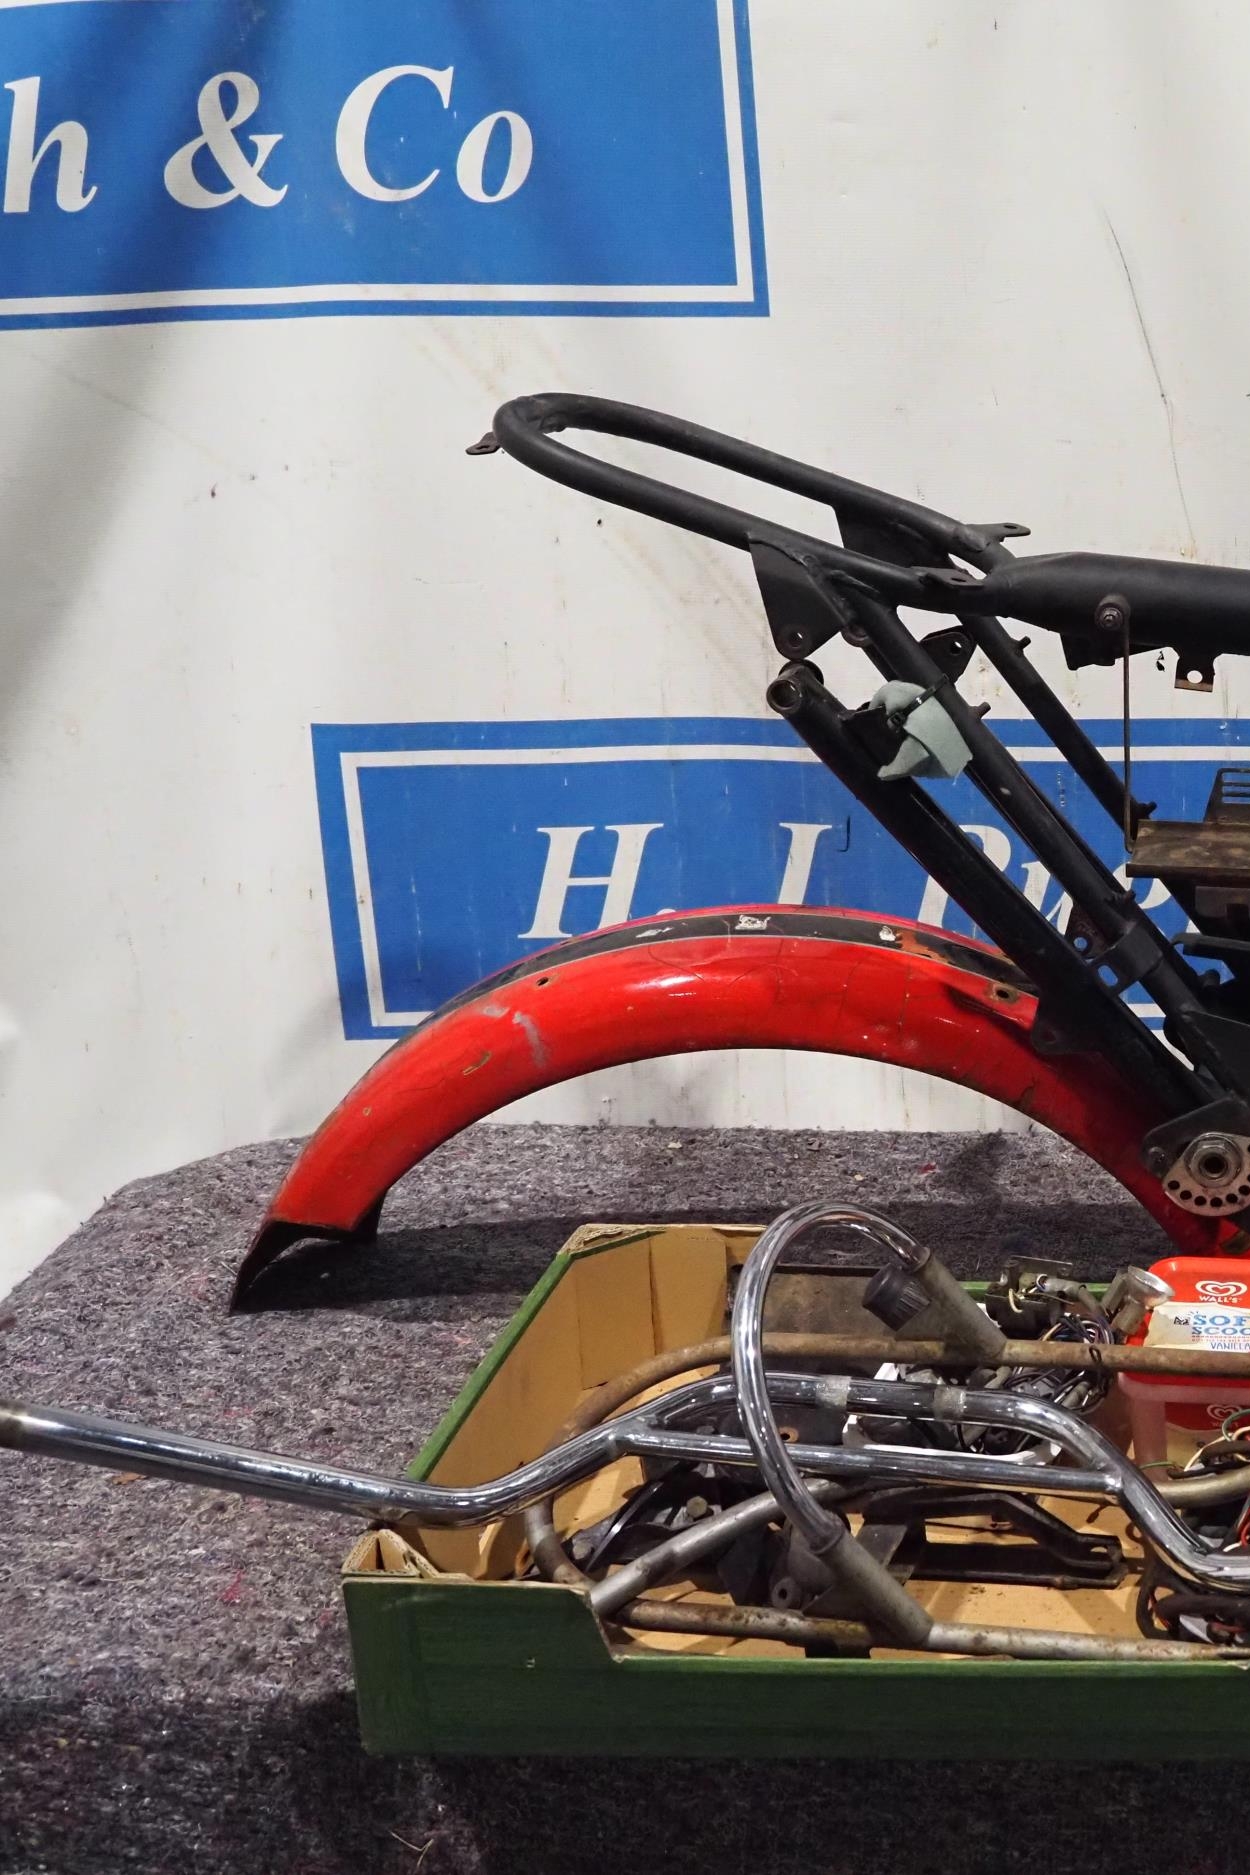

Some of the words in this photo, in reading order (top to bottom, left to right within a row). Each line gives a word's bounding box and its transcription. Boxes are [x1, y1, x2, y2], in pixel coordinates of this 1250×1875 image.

[164, 71, 289, 209] &
[335, 64, 534, 204] Co
[1198, 1295, 1239, 1304] WALL'S
